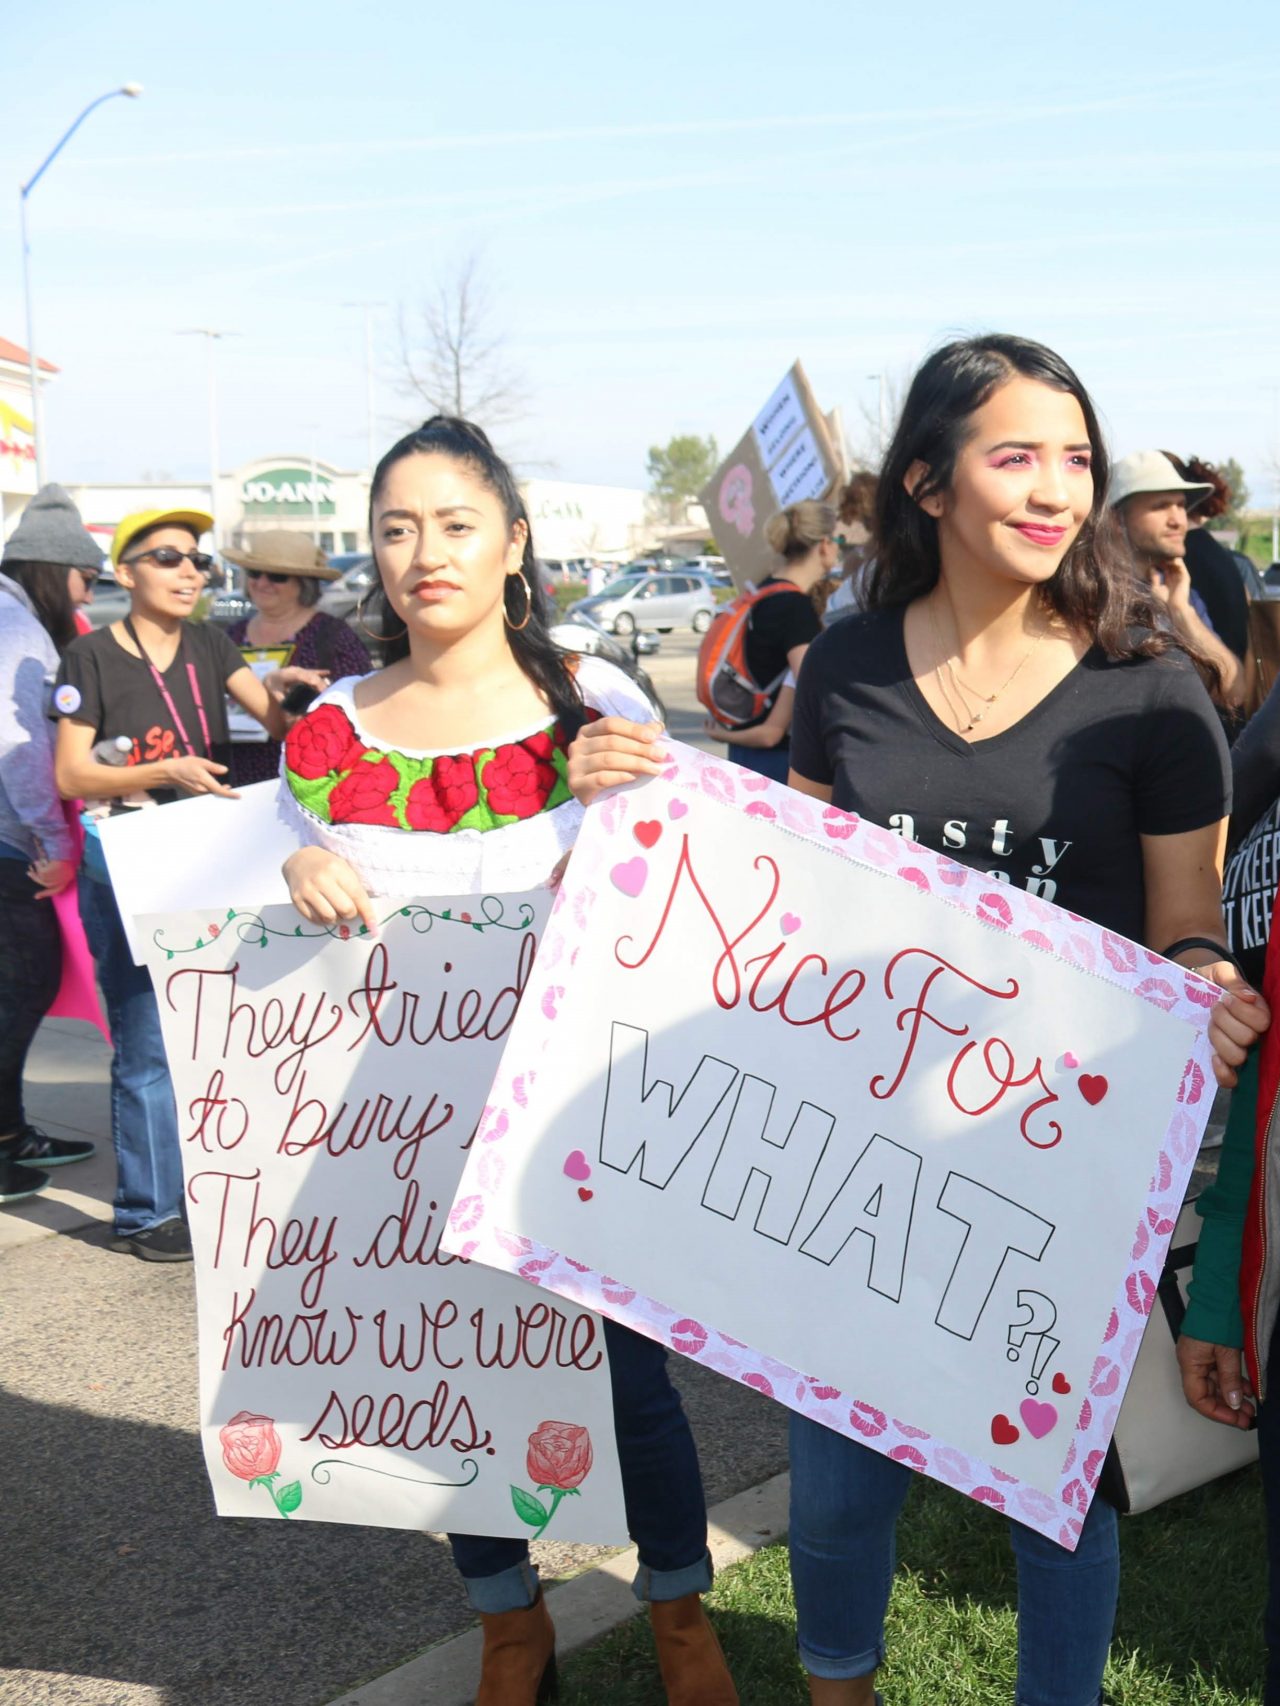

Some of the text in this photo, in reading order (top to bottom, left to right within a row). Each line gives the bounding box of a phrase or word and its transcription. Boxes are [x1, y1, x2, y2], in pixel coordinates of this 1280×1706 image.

[888, 813, 1073, 876] asty
[1241, 887, 1279, 950] KEE
[166, 932, 538, 1095] They tried
[614, 833, 1063, 1150] Nice For
[187, 1070, 453, 1179] to bury
[188, 1168, 337, 1308] They
[470, 1302, 603, 1370] were
[300, 1380, 496, 1456] seeds.
